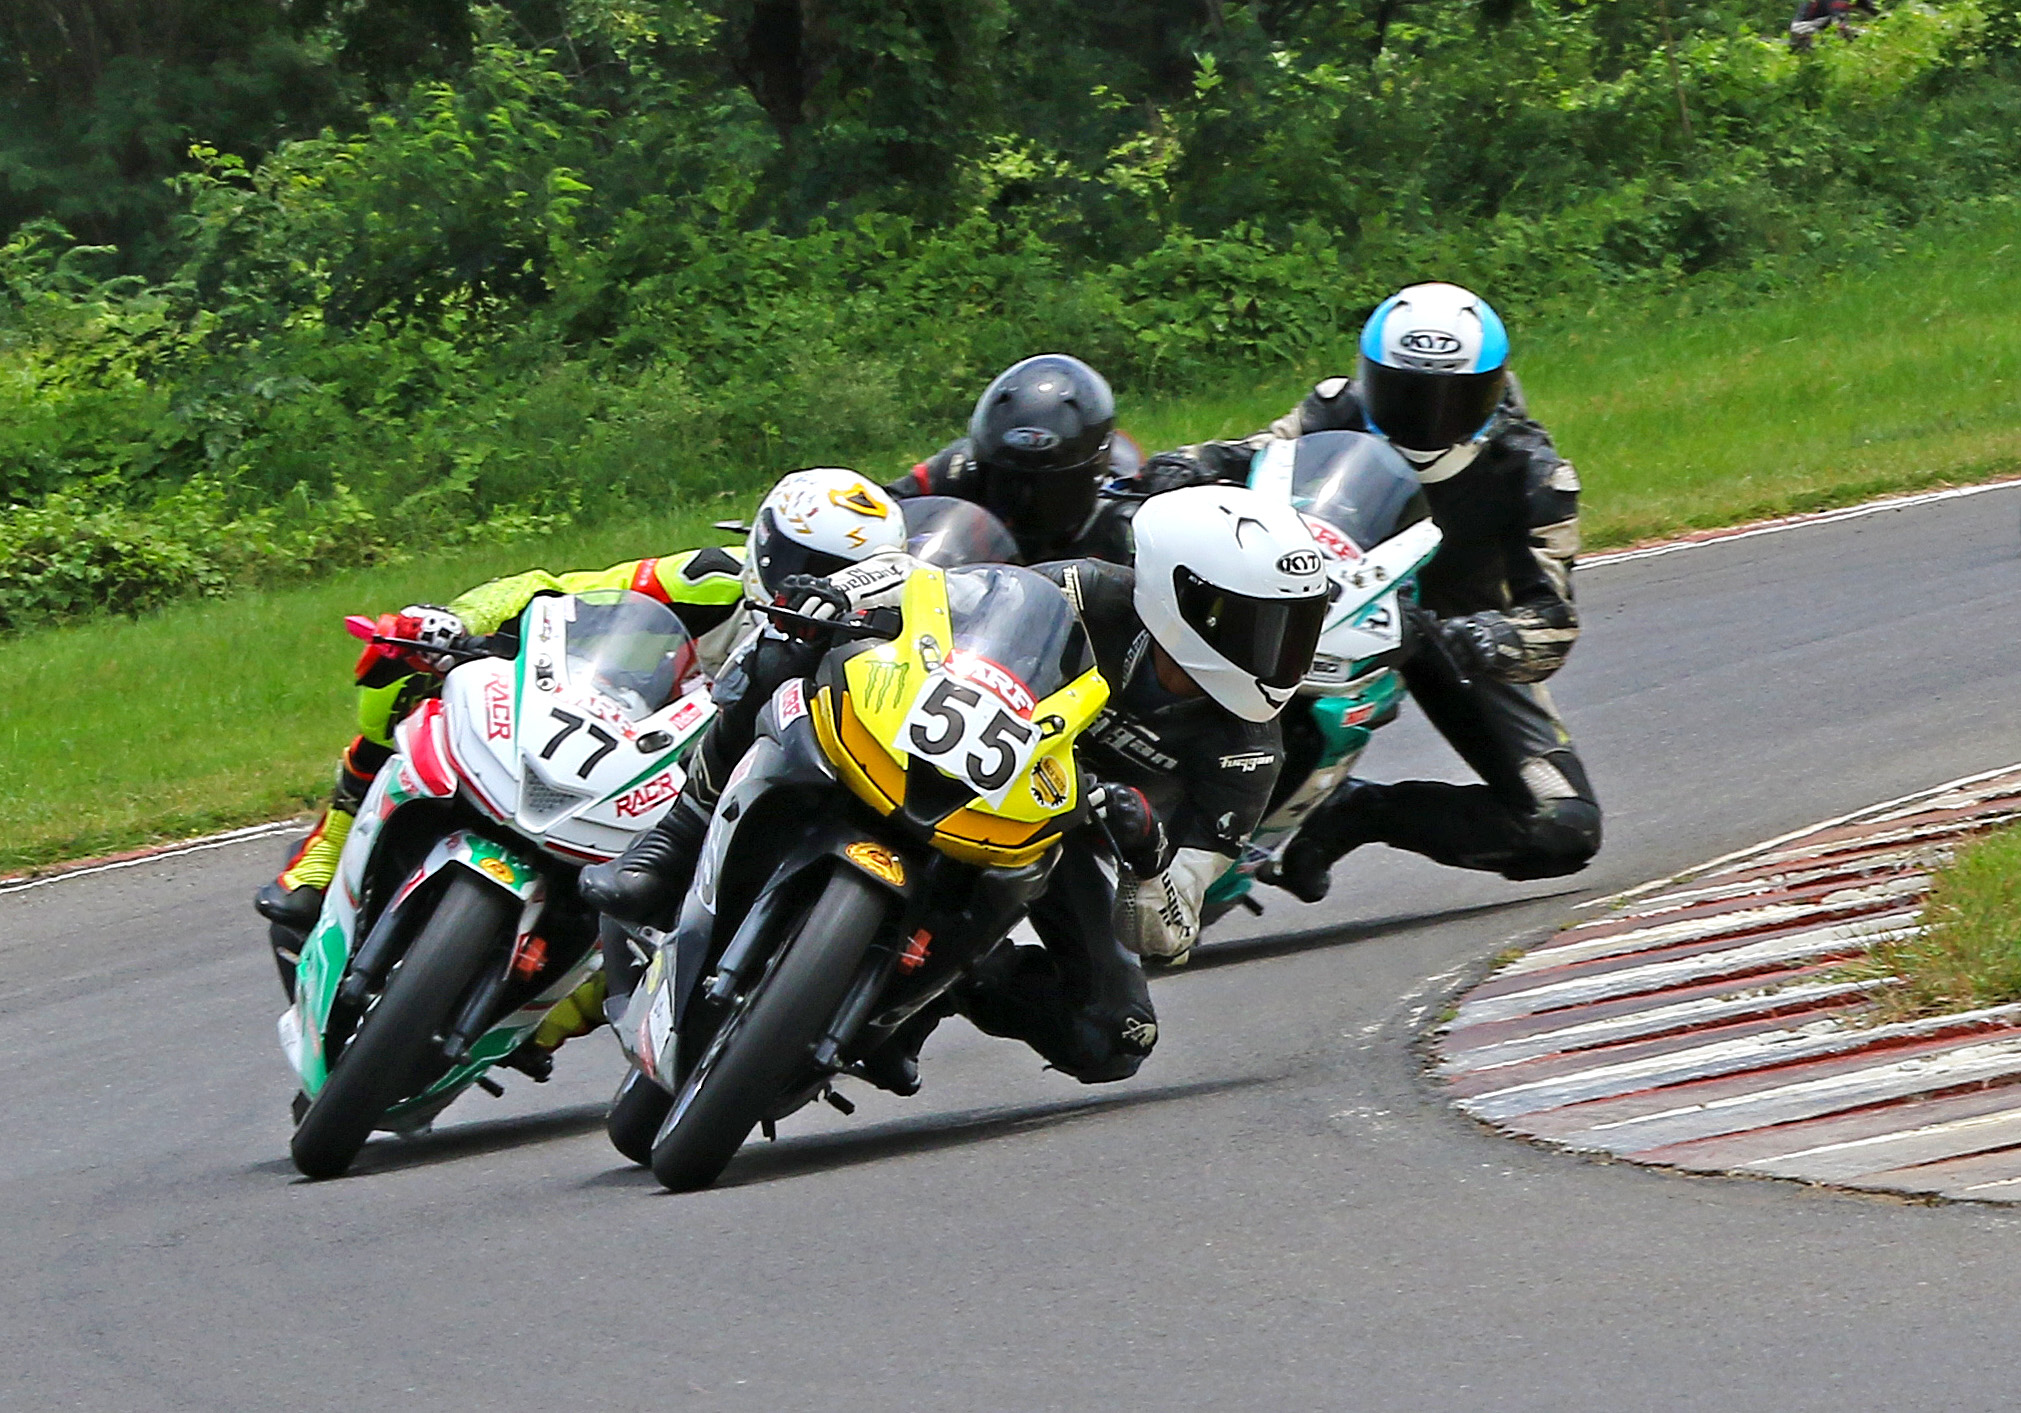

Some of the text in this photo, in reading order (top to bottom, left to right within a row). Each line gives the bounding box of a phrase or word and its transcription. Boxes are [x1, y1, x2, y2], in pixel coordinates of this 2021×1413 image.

[1278, 553, 1319, 574] KYT
[484, 672, 512, 741] RACR
[909, 677, 1033, 791] 55
[539, 706, 620, 780] 77
[614, 772, 680, 818] RACR
